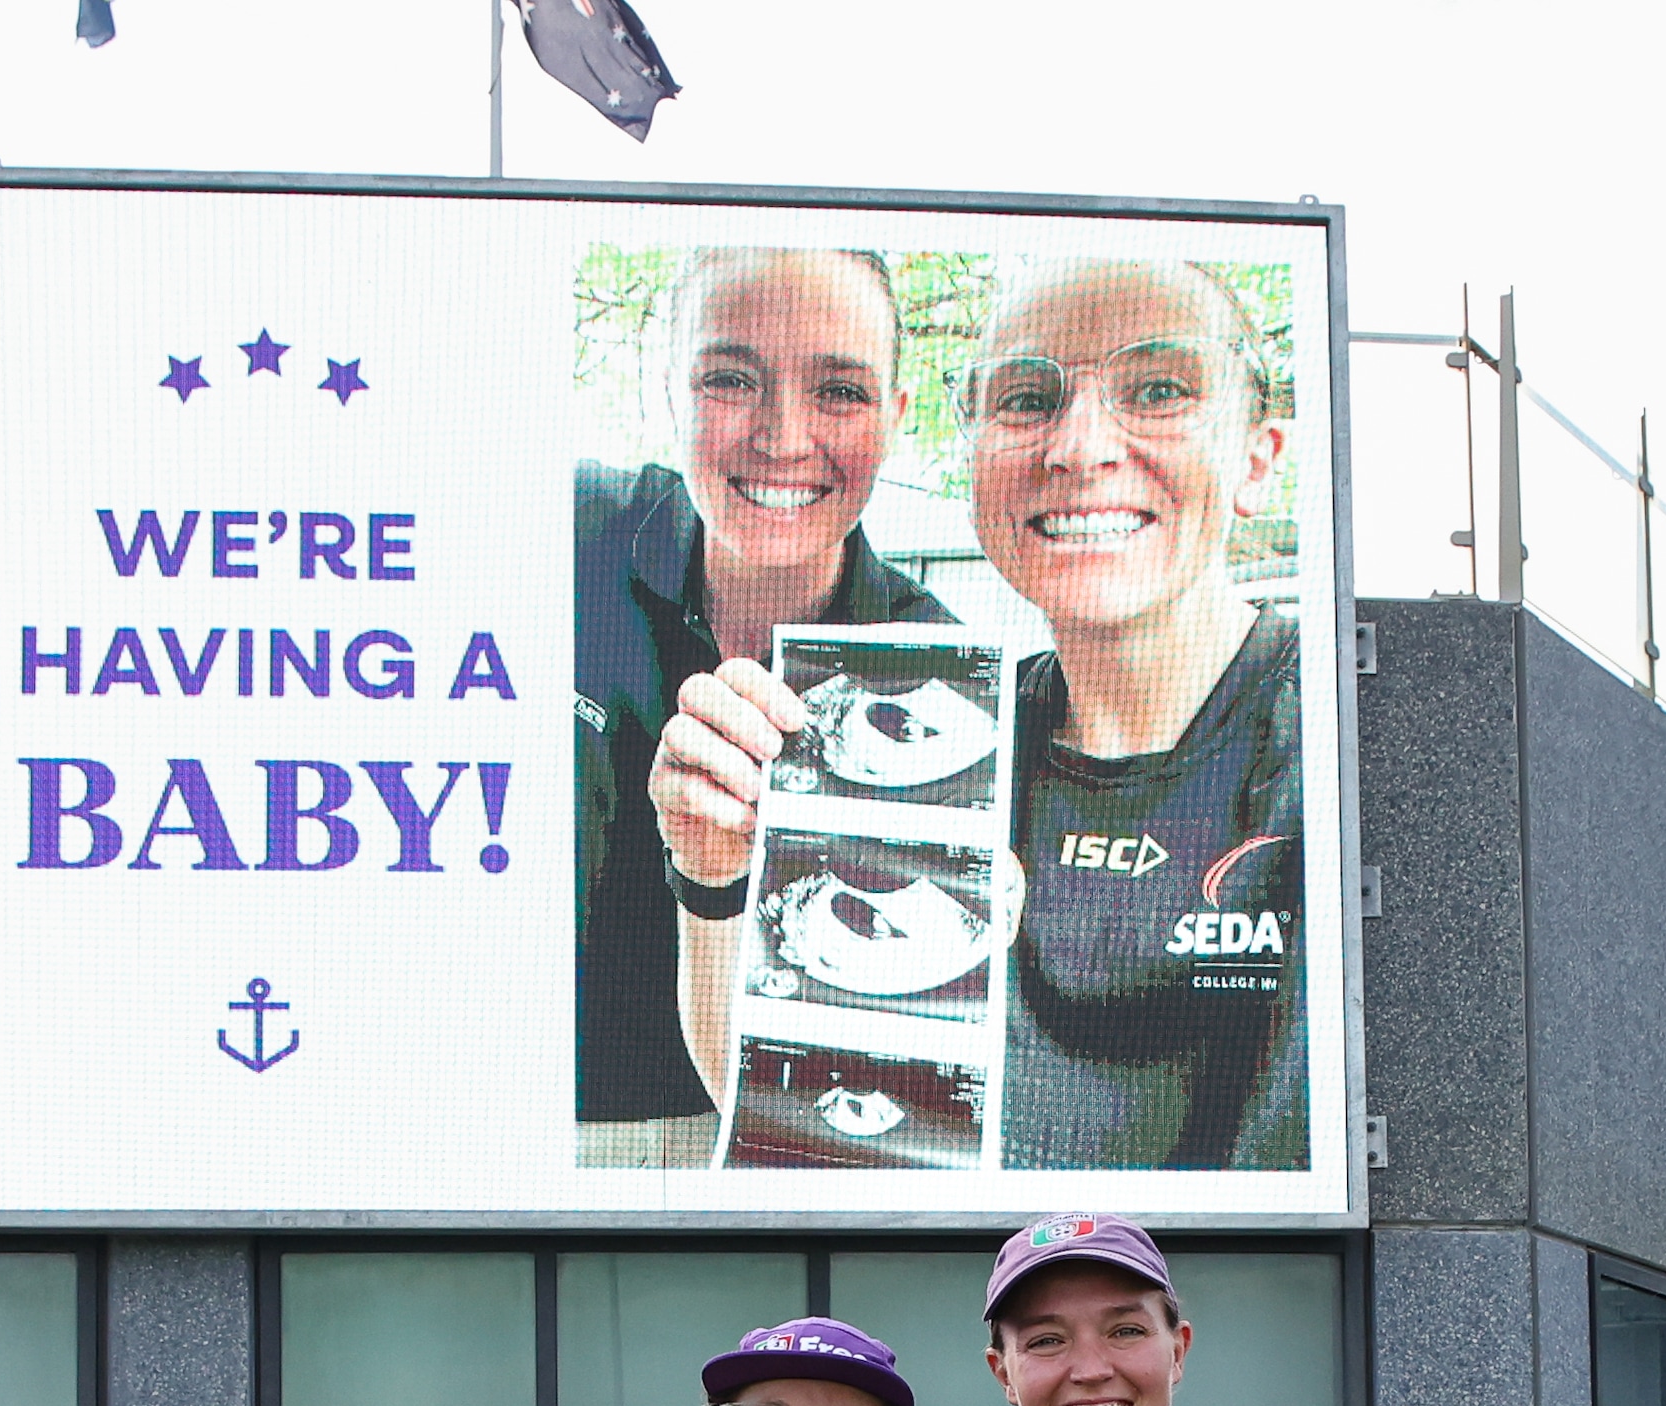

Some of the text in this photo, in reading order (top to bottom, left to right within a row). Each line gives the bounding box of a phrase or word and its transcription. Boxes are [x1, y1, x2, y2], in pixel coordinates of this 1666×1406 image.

[96, 509, 416, 581] WE’RE
[20, 626, 517, 699] HAVING A
[16, 757, 512, 873] BABY!
